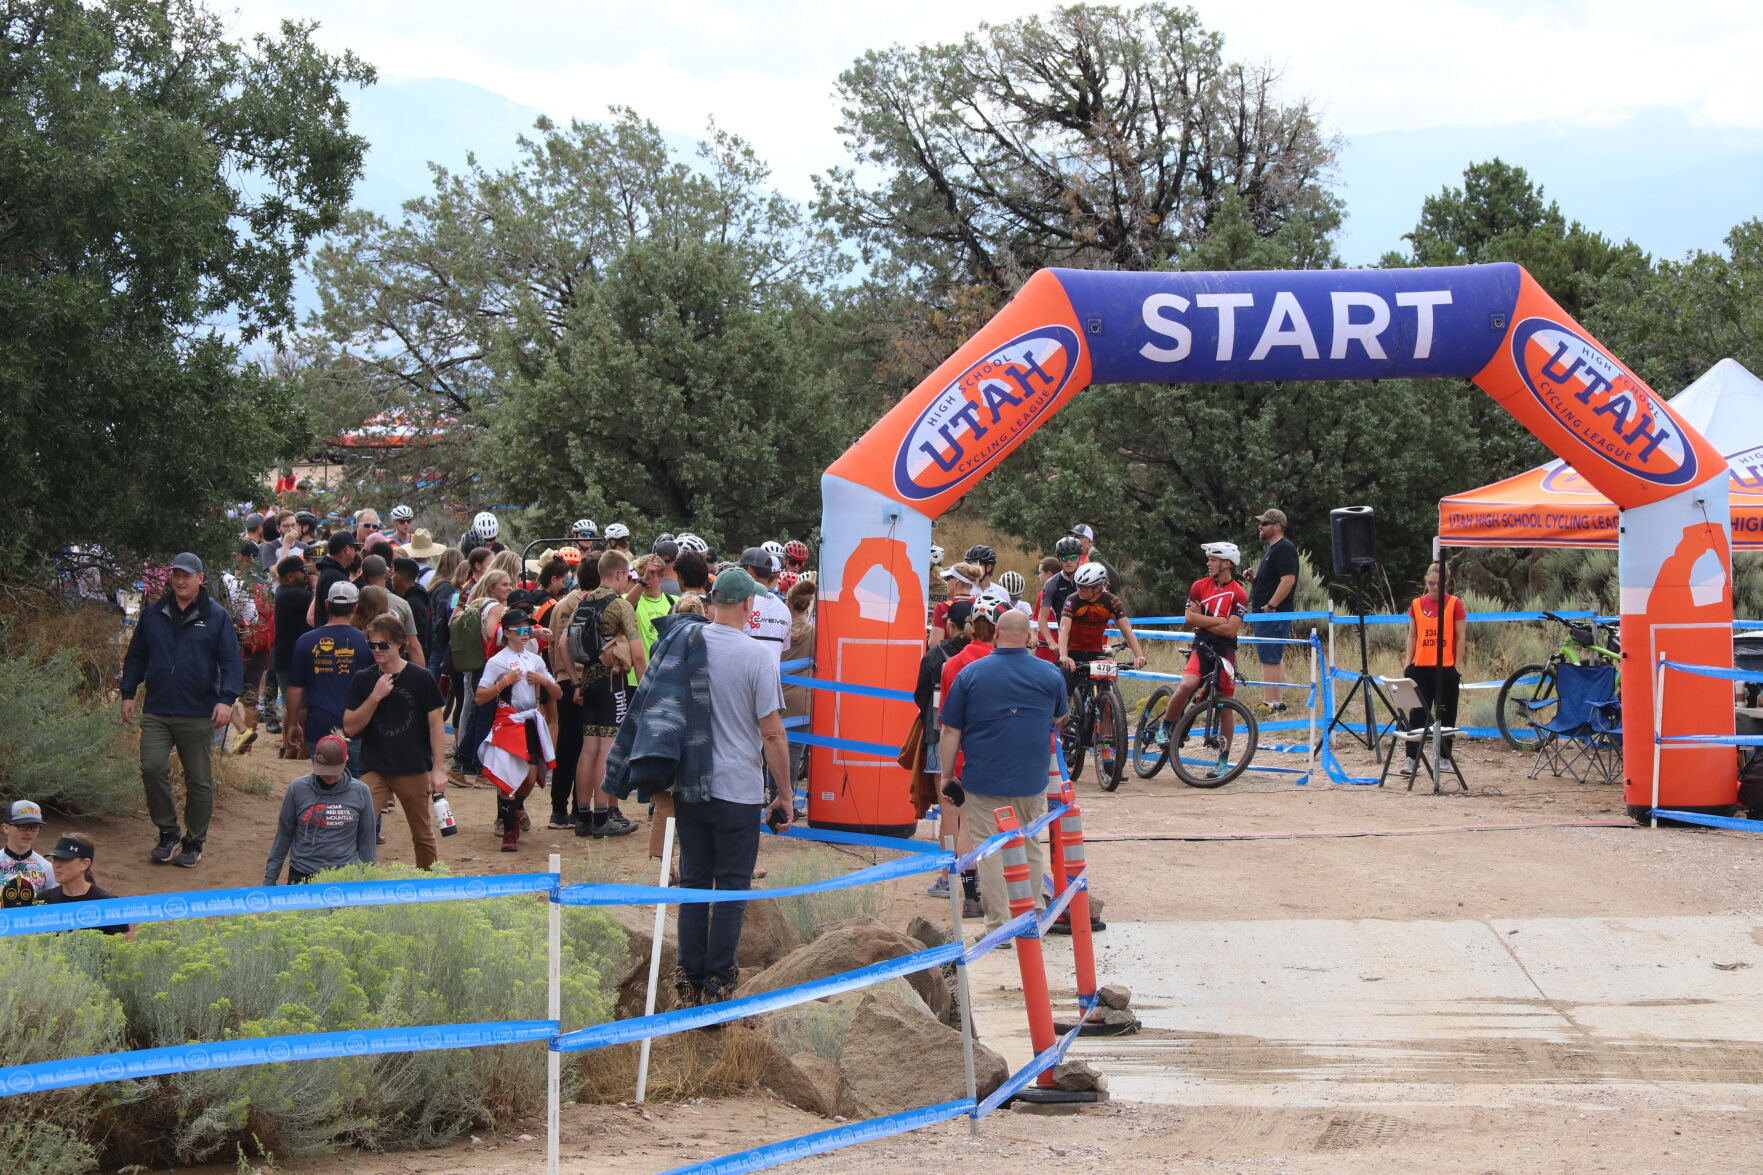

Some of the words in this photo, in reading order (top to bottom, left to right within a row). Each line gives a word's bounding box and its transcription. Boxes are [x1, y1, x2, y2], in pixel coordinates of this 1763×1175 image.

[1139, 290, 1453, 363] START
[919, 350, 1055, 472] UTAH
[927, 396, 956, 427] HIGH
[958, 354, 1012, 392] SCHOOL
[1541, 340, 1670, 464] UTAH
[1582, 346, 1612, 371] HIGH
[1618, 373, 1659, 418] SCHOOL
[958, 433, 1008, 472] CYCLING
[1010, 390, 1050, 432] LEAGUE
[1540, 382, 1582, 428] CYCLING
[1584, 428, 1633, 461] LEAGUE
[1449, 513, 1473, 528] UTAH
[1475, 514, 1499, 527] HIGH
[1502, 513, 1542, 528] SCHOOL
[1545, 514, 1589, 529] CYCLING
[1097, 664, 1111, 672] 478
